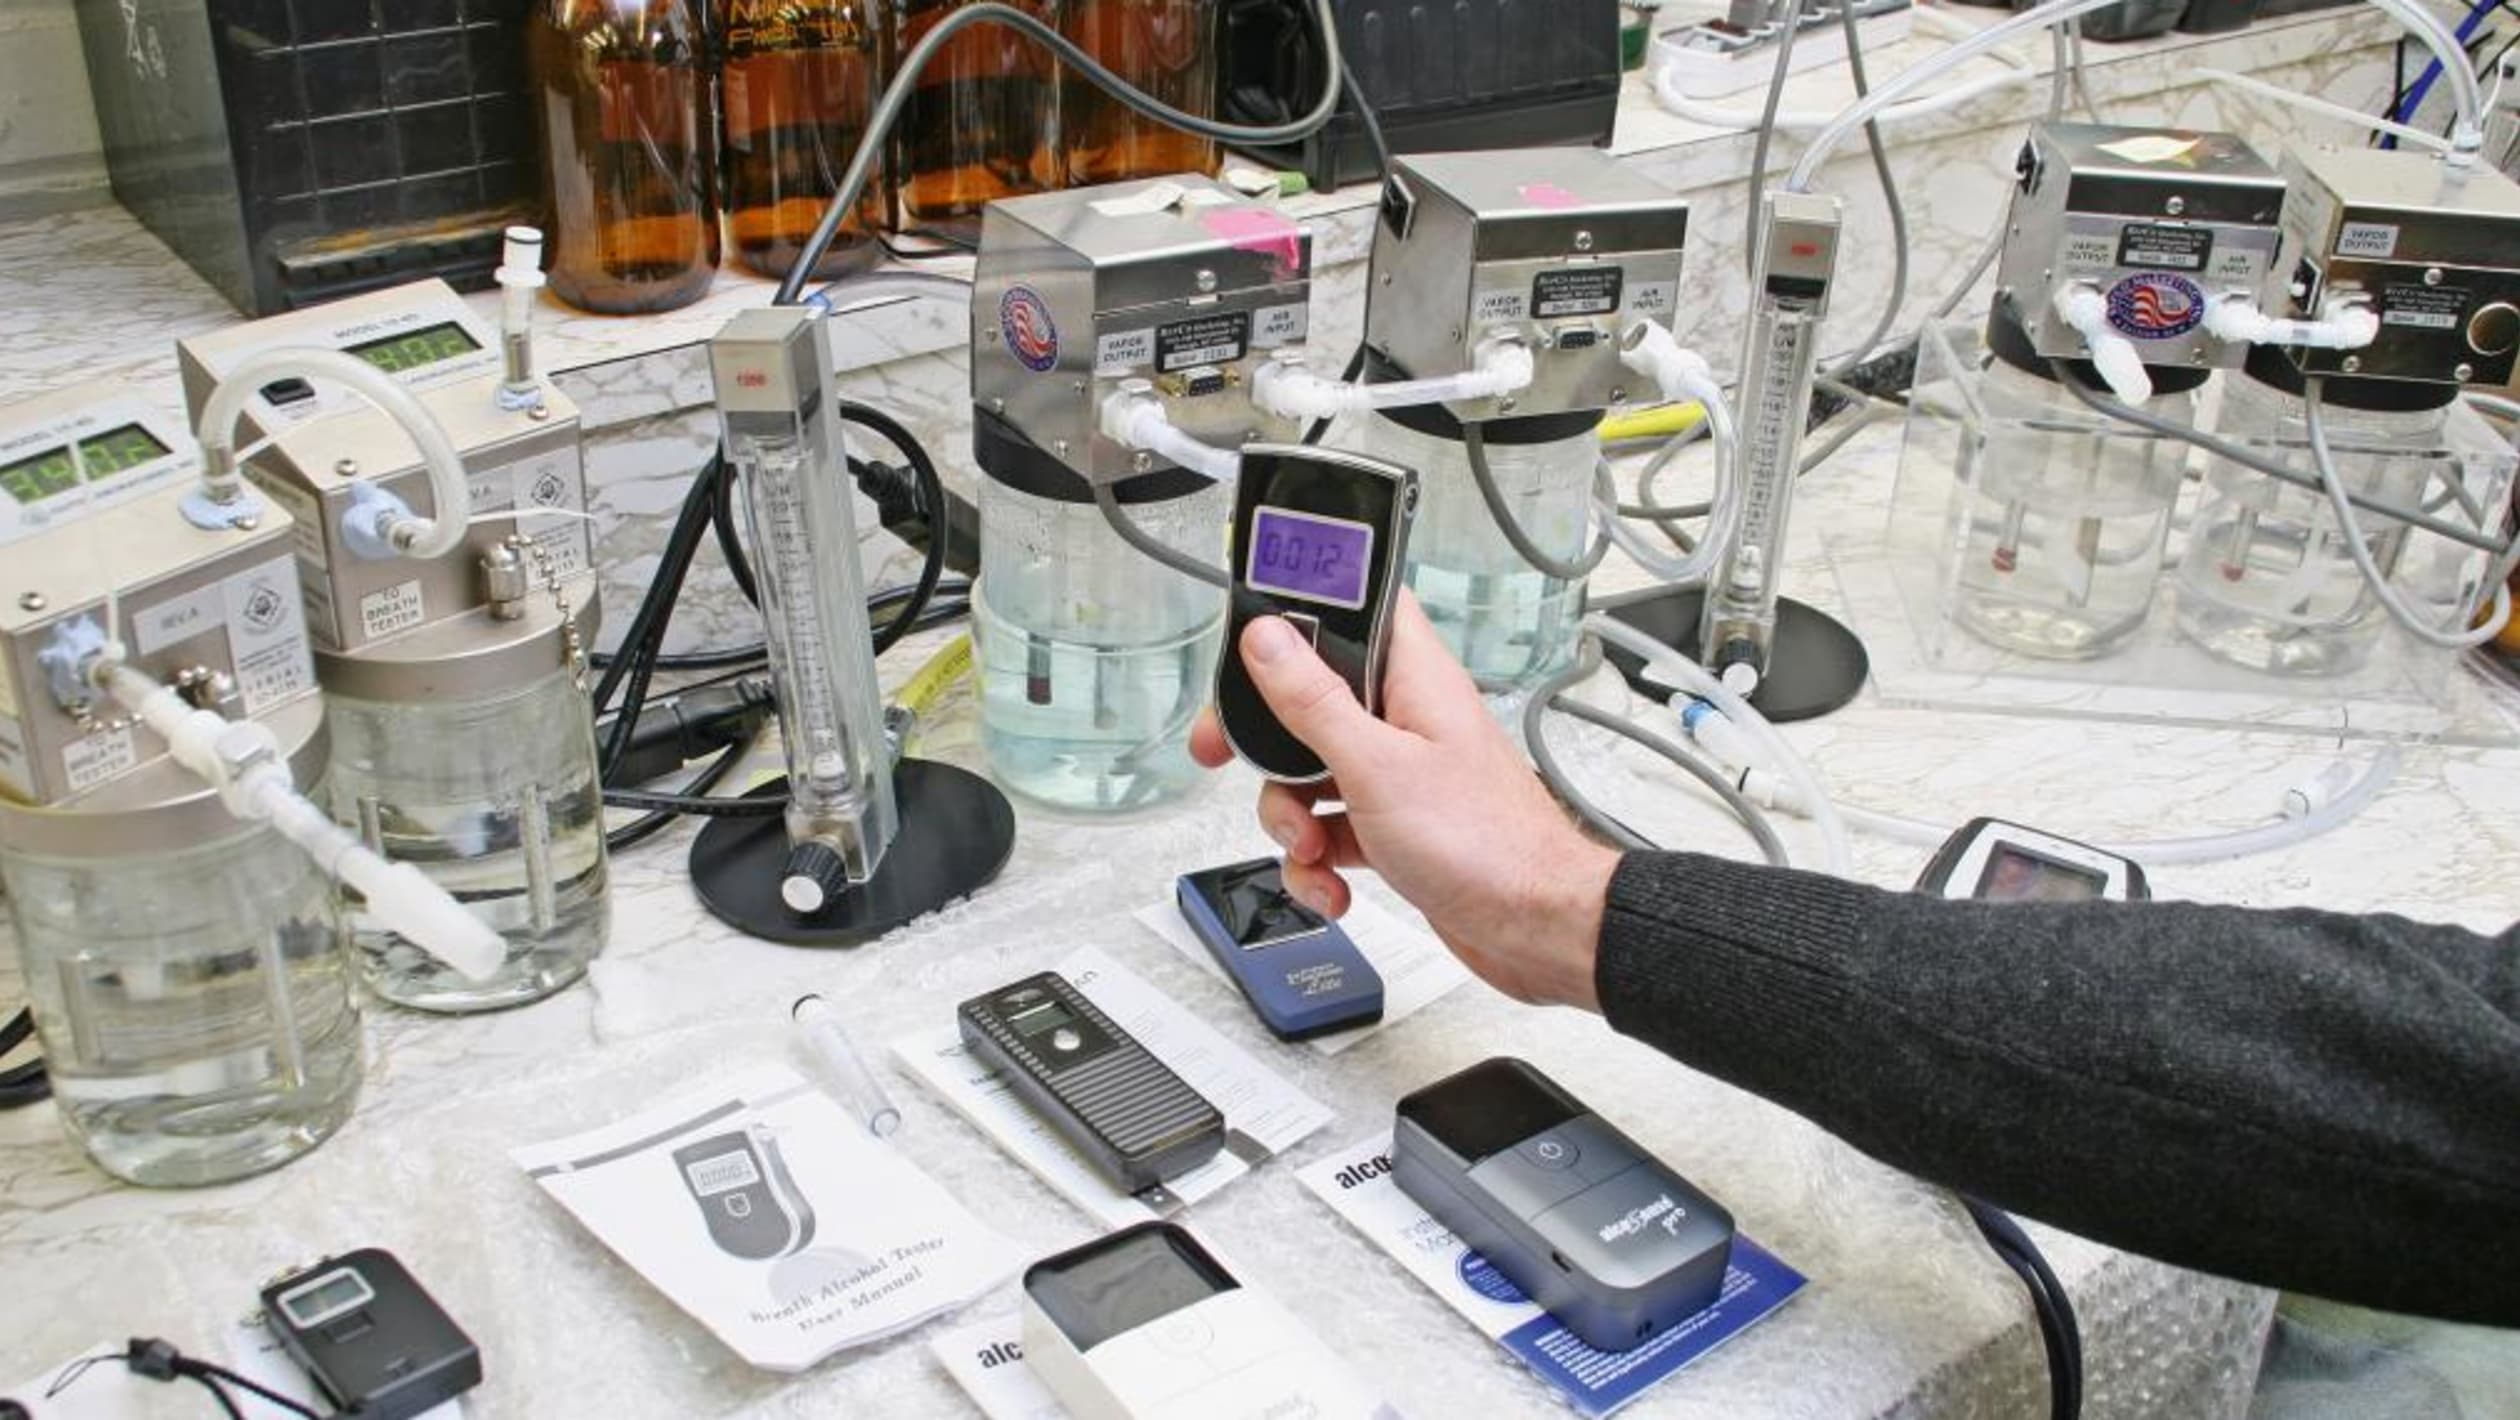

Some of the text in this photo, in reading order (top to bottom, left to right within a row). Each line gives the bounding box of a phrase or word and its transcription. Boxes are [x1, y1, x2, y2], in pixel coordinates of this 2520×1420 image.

[366, 593, 418, 621] BREATH
[370, 609, 419, 633] TESTER
[750, 1237, 946, 1324] Breath Alcohol Tester
[798, 1266, 924, 1331] User Manual
